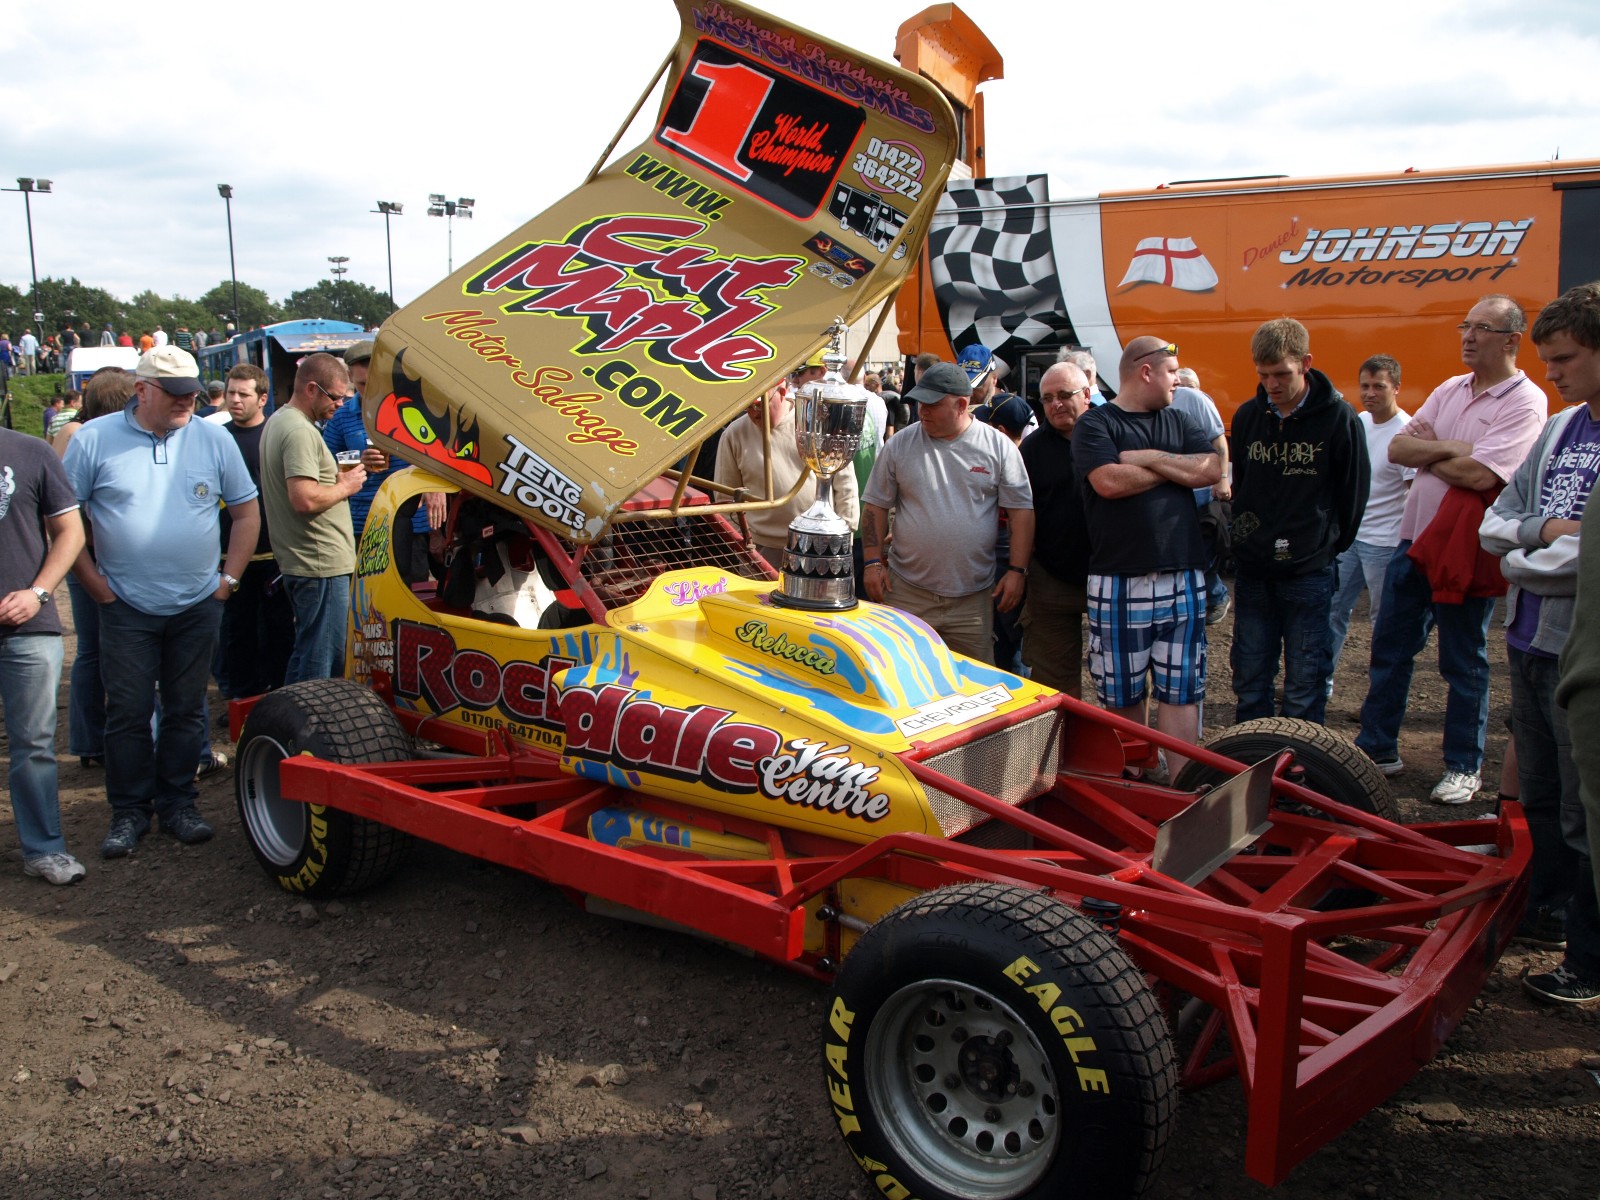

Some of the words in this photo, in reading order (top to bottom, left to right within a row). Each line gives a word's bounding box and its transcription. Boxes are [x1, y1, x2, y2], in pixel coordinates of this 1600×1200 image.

[691, 7, 936, 134] MOTORHOMES
[704, 2, 796, 52] Richard
[802, 43, 911, 101] Baldwin
[661, 59, 776, 182] 1
[775, 113, 829, 151] World
[749, 130, 835, 177] Champion
[852, 153, 923, 202] 364222
[867, 137, 922, 178] 01422
[574, 213, 806, 306] Cut
[1243, 219, 1299, 270] Daniel
[1279, 219, 1534, 264] JOHNSON
[1284, 259, 1515, 288] Motorsport
[468, 243, 777, 381] Maple
[422, 310, 522, 370] Motor
[511, 366, 640, 457] Salvage
[580, 359, 707, 438] .COM
[496, 462, 586, 531] TOOLS
[502, 434, 584, 506] TENG
[664, 577, 729, 606] Lisa
[735, 619, 836, 676] Rebecca
[461, 711, 503, 730] 01706
[508, 722, 562, 748] 647704
[903, 689, 1006, 731] CHEVROLET
[757, 755, 890, 820] Centre
[785, 738, 882, 787] Van
[1002, 955, 1111, 1095] EAGLE
